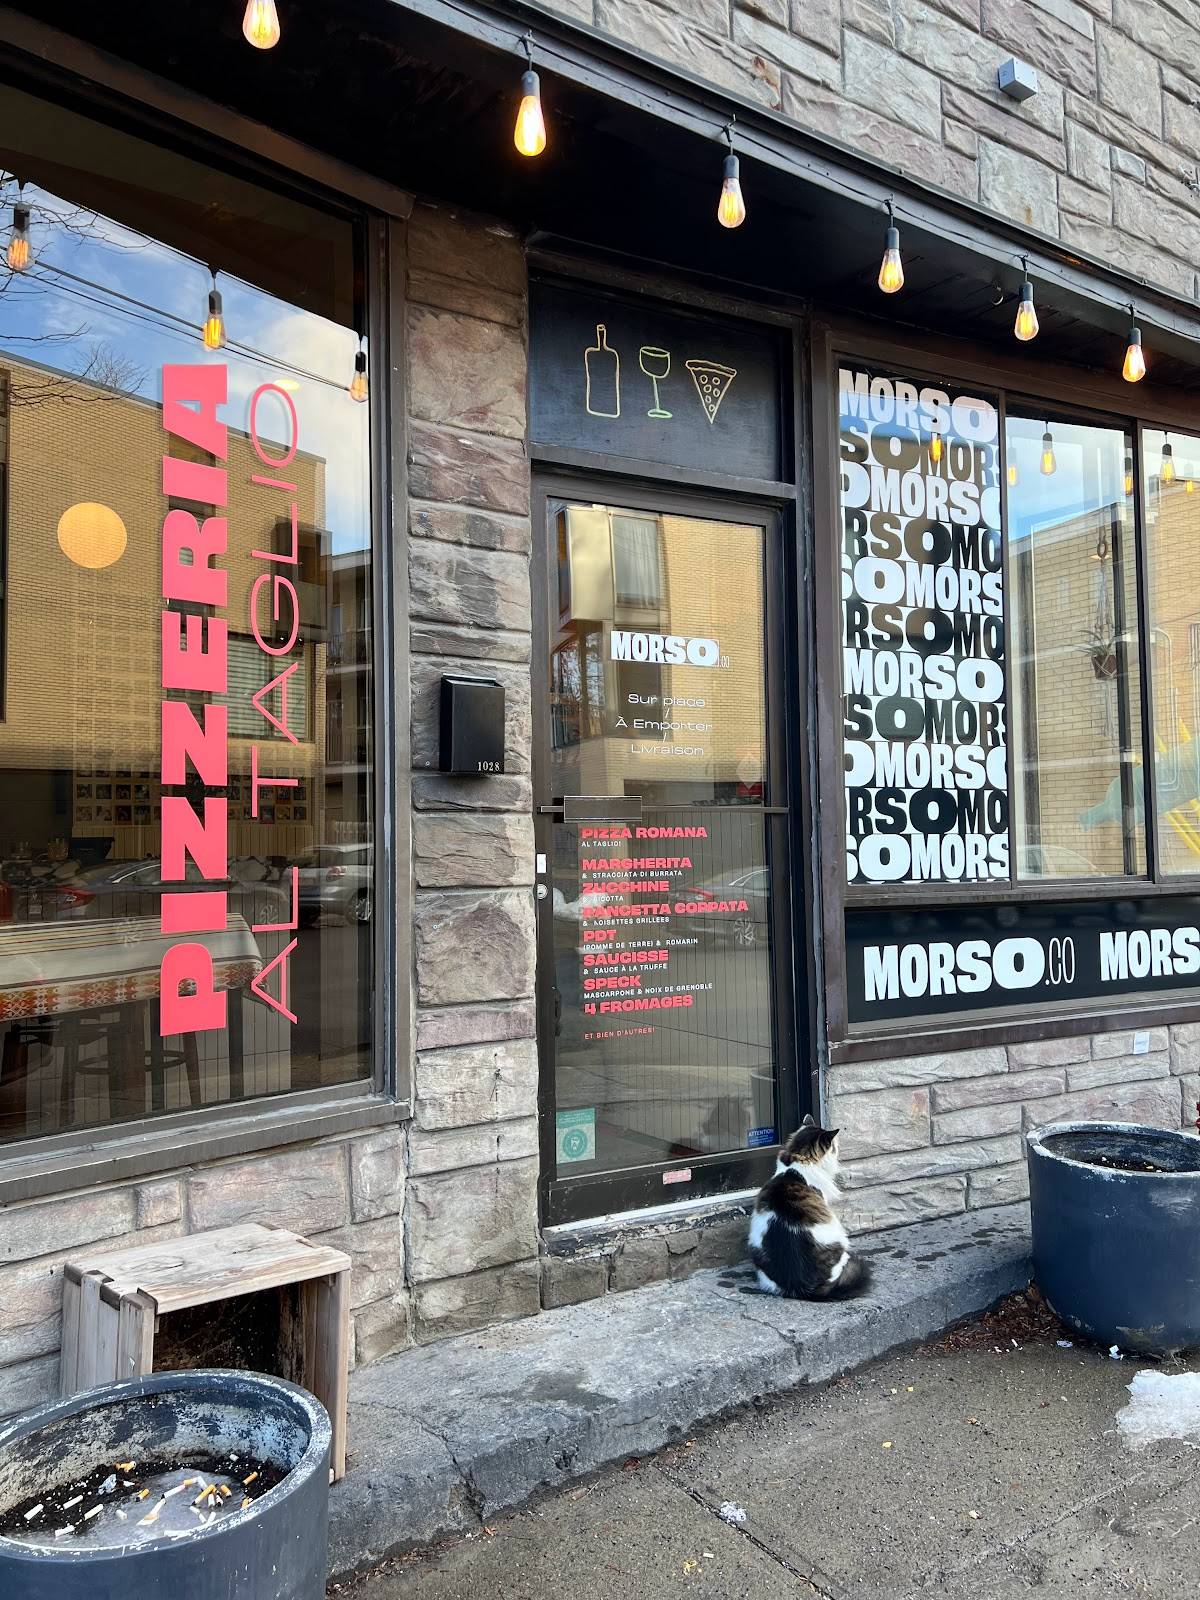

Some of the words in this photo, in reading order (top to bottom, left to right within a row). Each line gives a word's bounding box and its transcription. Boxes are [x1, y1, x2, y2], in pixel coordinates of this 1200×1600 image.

[839, 368, 998, 443] MORSO
[250, 383, 299, 819] TAGLIO
[844, 648, 1004, 702] MORSO
[160, 363, 228, 1036] PIZZERIA
[628, 693, 657, 705] Sur
[663, 695, 706, 707] place
[615, 715, 628, 728] À
[633, 718, 713, 732] Emporter
[631, 744, 704, 756] Livraison
[477, 760, 500, 771] 1028
[581, 826, 632, 839] PIZZA
[635, 826, 708, 839] ROMANA
[582, 857, 693, 871] MARGHERITA
[592, 871, 638, 879] STRACCIATA
[650, 870, 683, 878] BURRATA
[582, 880, 670, 894] ZUCCHINE
[583, 902, 672, 918] PANCETTA
[674, 899, 749, 914] COPPATA
[593, 918, 634, 926] NOISETTES
[583, 929, 617, 943] PDT
[629, 940, 654, 948] TERRE)
[666, 937, 699, 946] ROMARIN
[250, 867, 299, 1025] AL
[583, 949, 669, 967] SAUCISSE
[621, 964, 627, 972] À
[640, 963, 668, 971] TRUFFE
[583, 975, 641, 991] SPECK
[583, 990, 635, 999] MASCARPONE
[645, 986, 663, 994] NOIX
[676, 982, 713, 991] GRENOBLE
[584, 1002, 597, 1016] 4
[600, 994, 694, 1014] FROMAGES
[597, 1031, 614, 1039] BIEN
